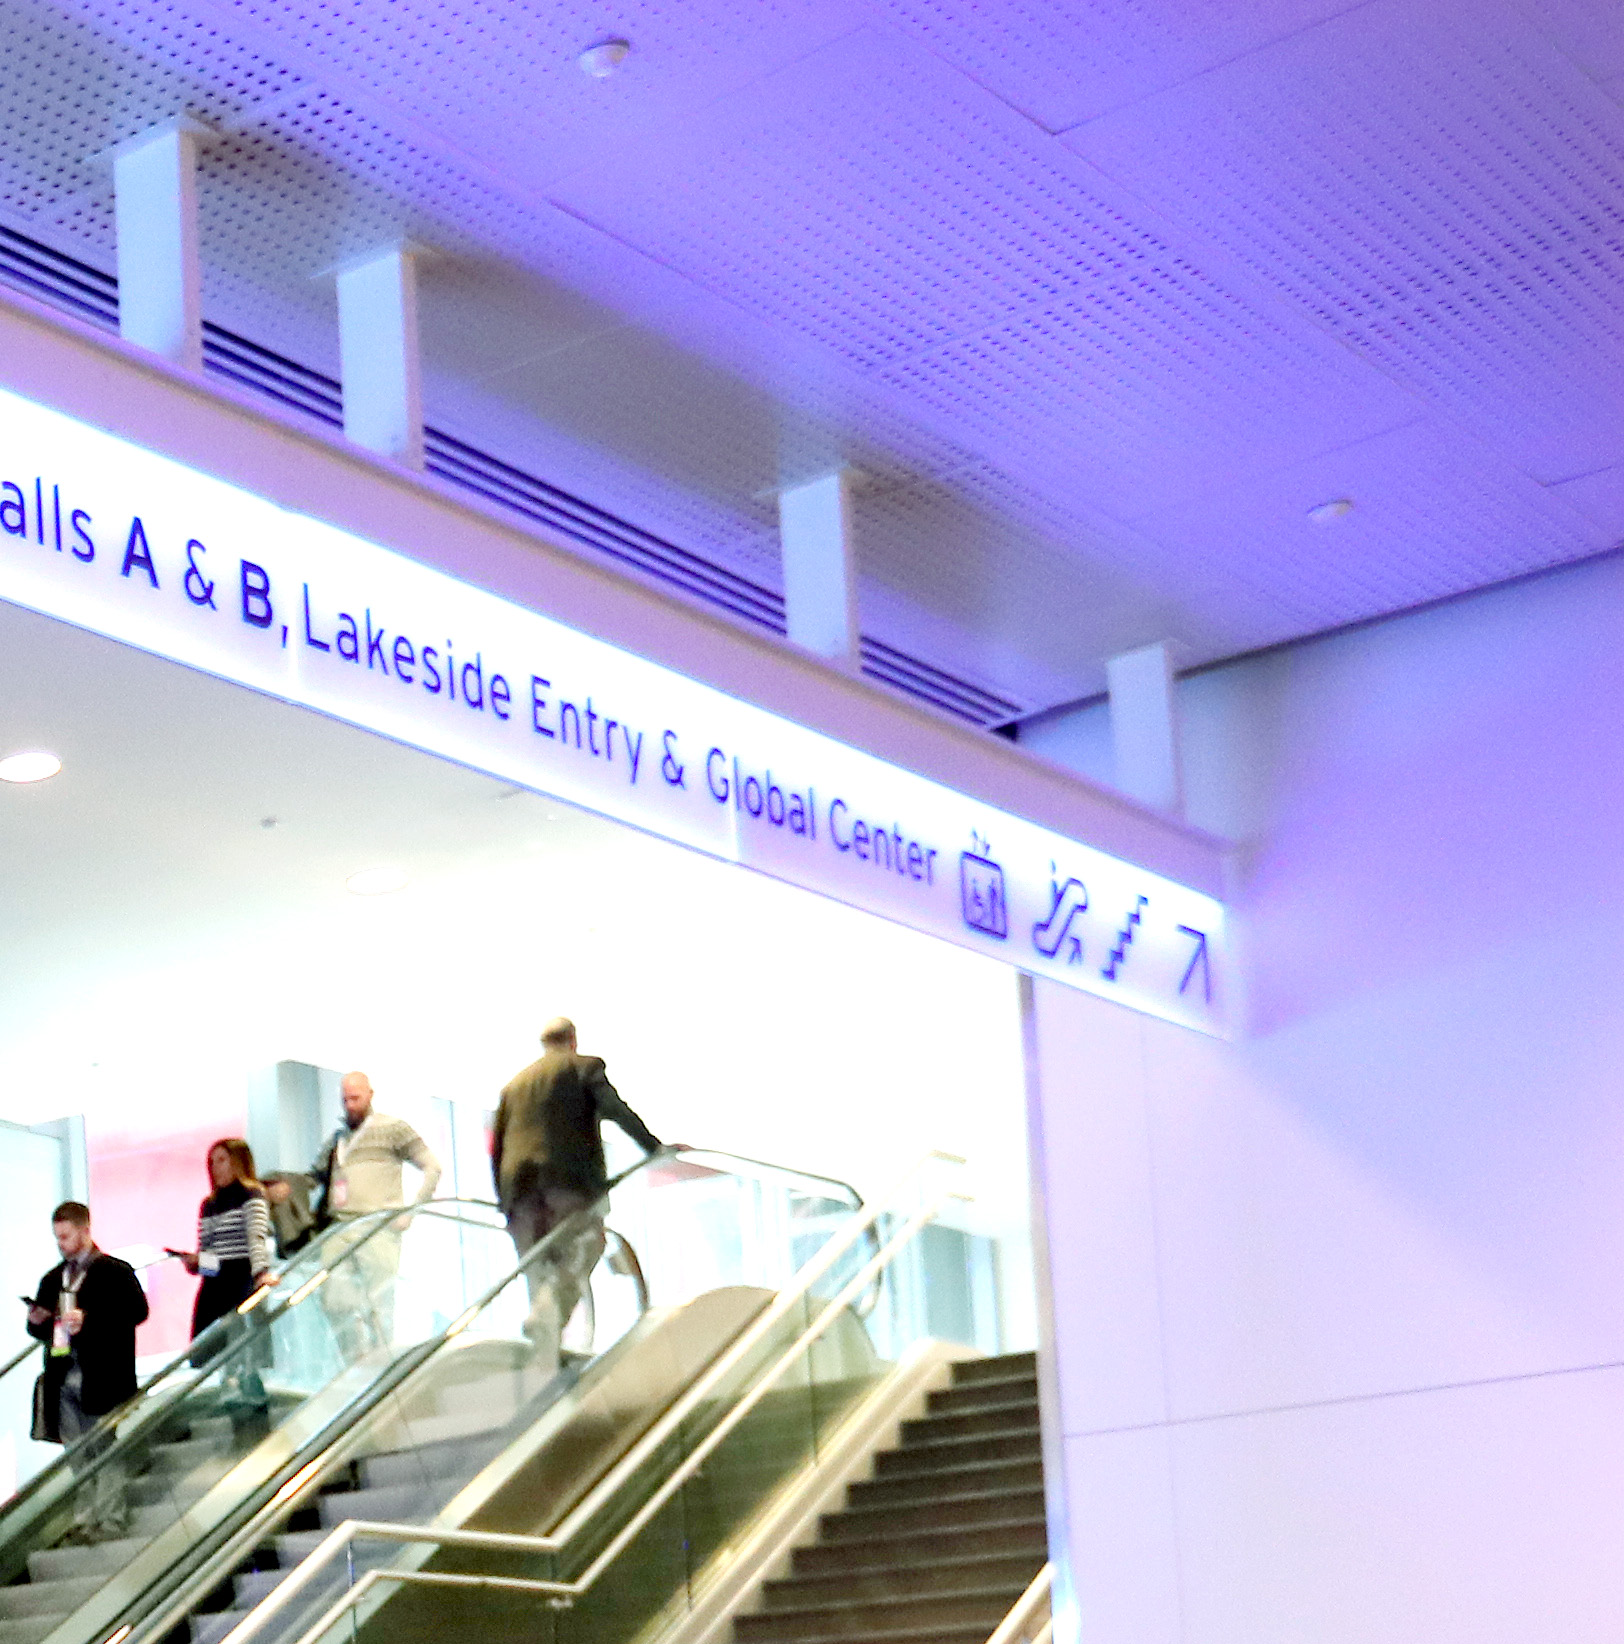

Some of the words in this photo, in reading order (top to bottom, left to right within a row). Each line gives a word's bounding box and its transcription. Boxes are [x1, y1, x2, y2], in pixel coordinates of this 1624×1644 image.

[120, 515, 160, 590] A
[182, 537, 218, 612] &
[239, 558, 290, 650] B,
[302, 582, 512, 723] Lakeside
[531, 676, 644, 786] Entry
[660, 730, 686, 790] &
[705, 745, 817, 842] Global
[829, 799, 937, 886] Center
